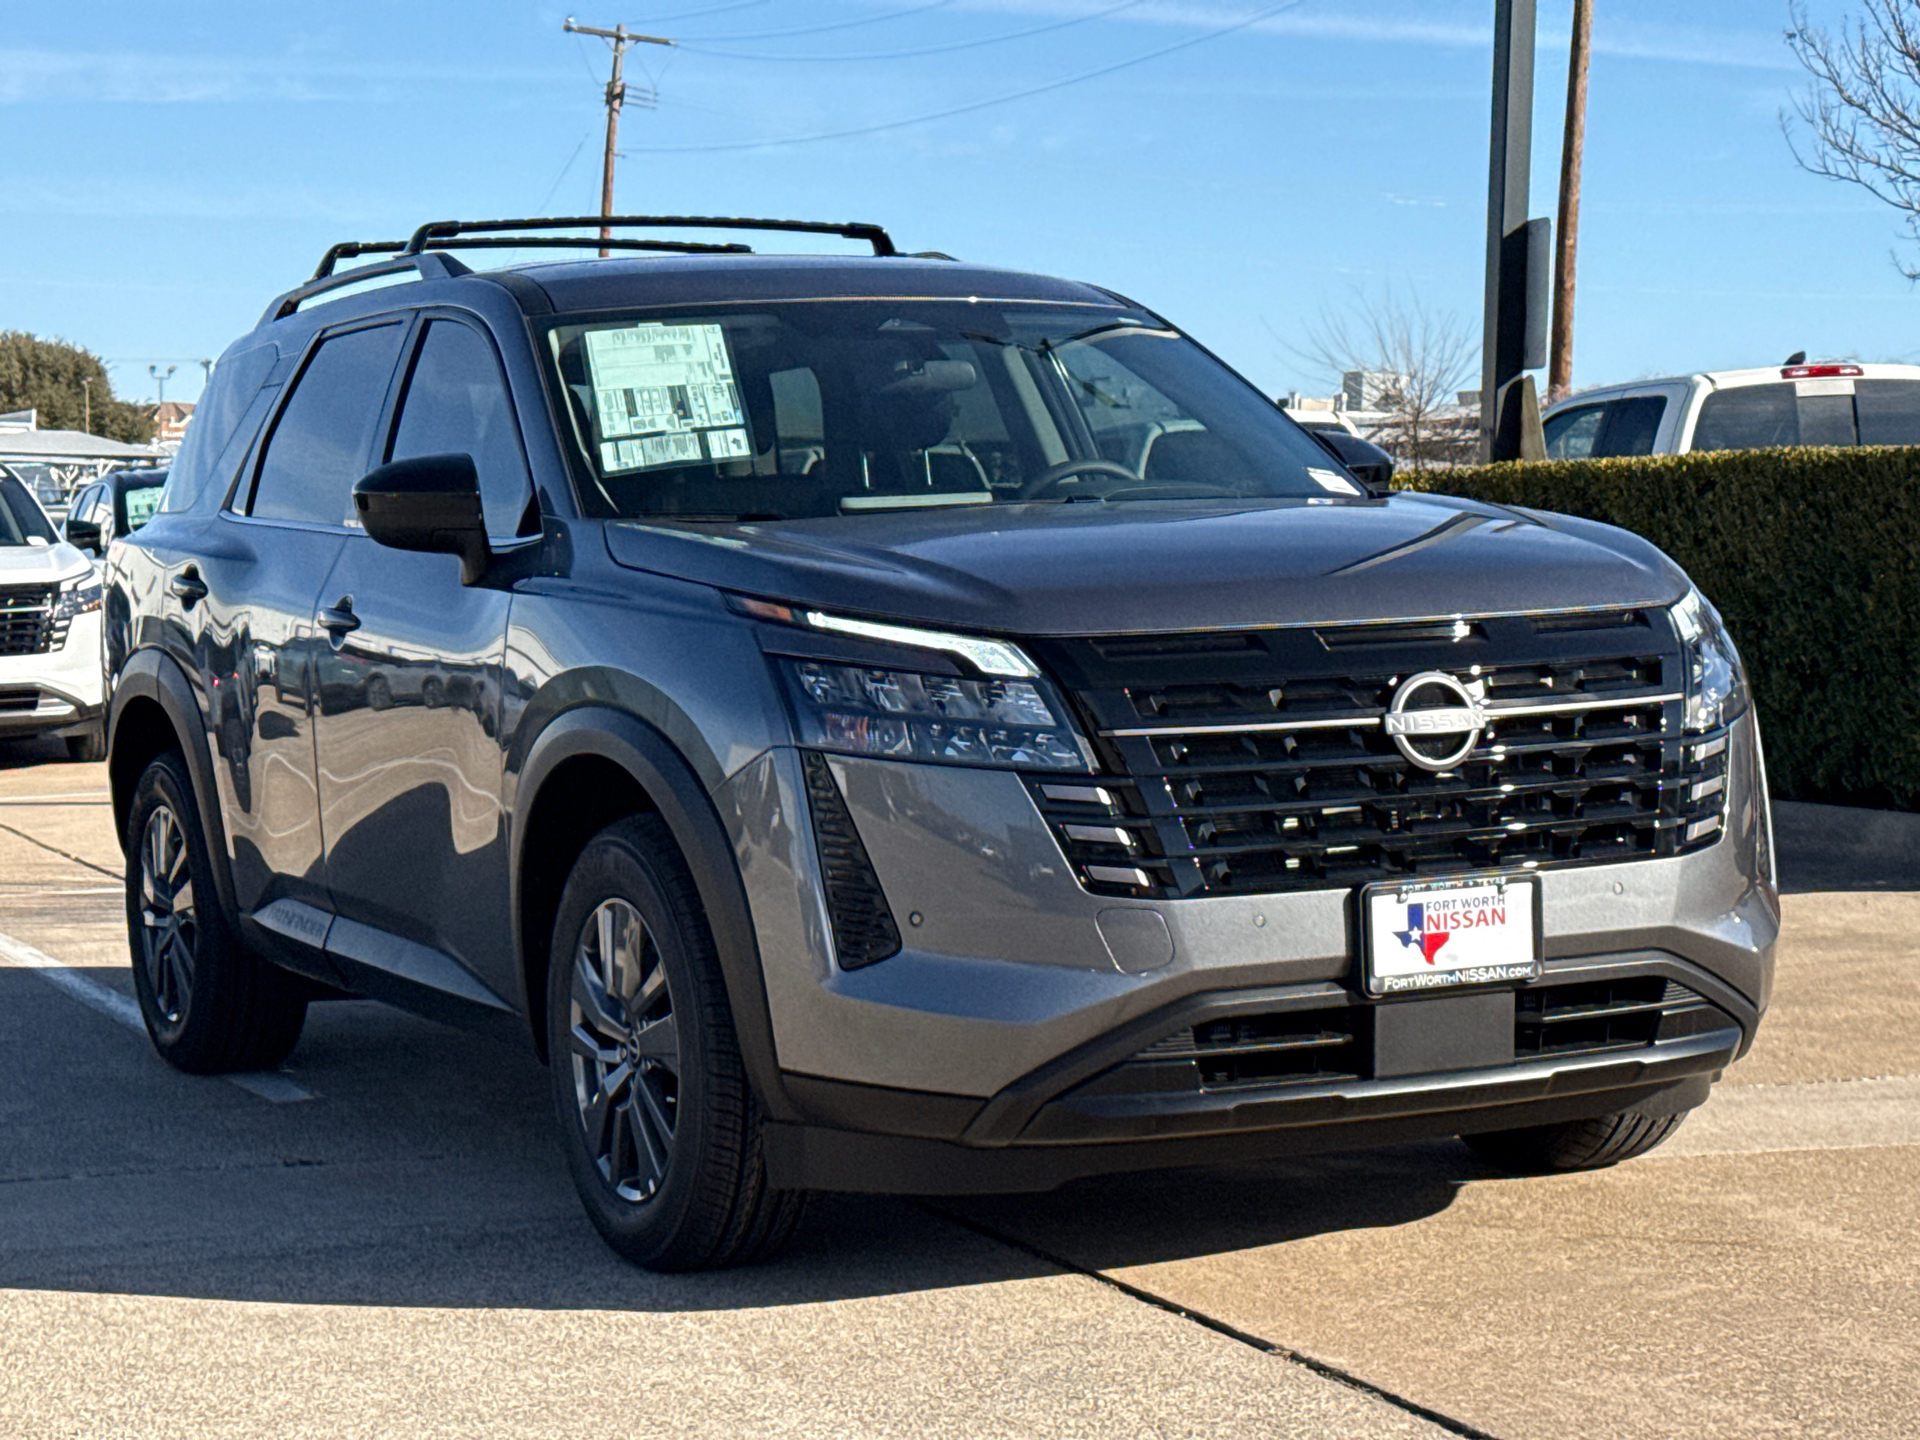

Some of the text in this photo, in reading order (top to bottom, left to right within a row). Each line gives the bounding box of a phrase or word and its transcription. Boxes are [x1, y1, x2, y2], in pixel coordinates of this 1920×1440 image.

[1387, 711, 1484, 733] NISSAN
[1425, 895, 1506, 913] FORT WORTH
[1426, 907, 1506, 932] NISSAN
